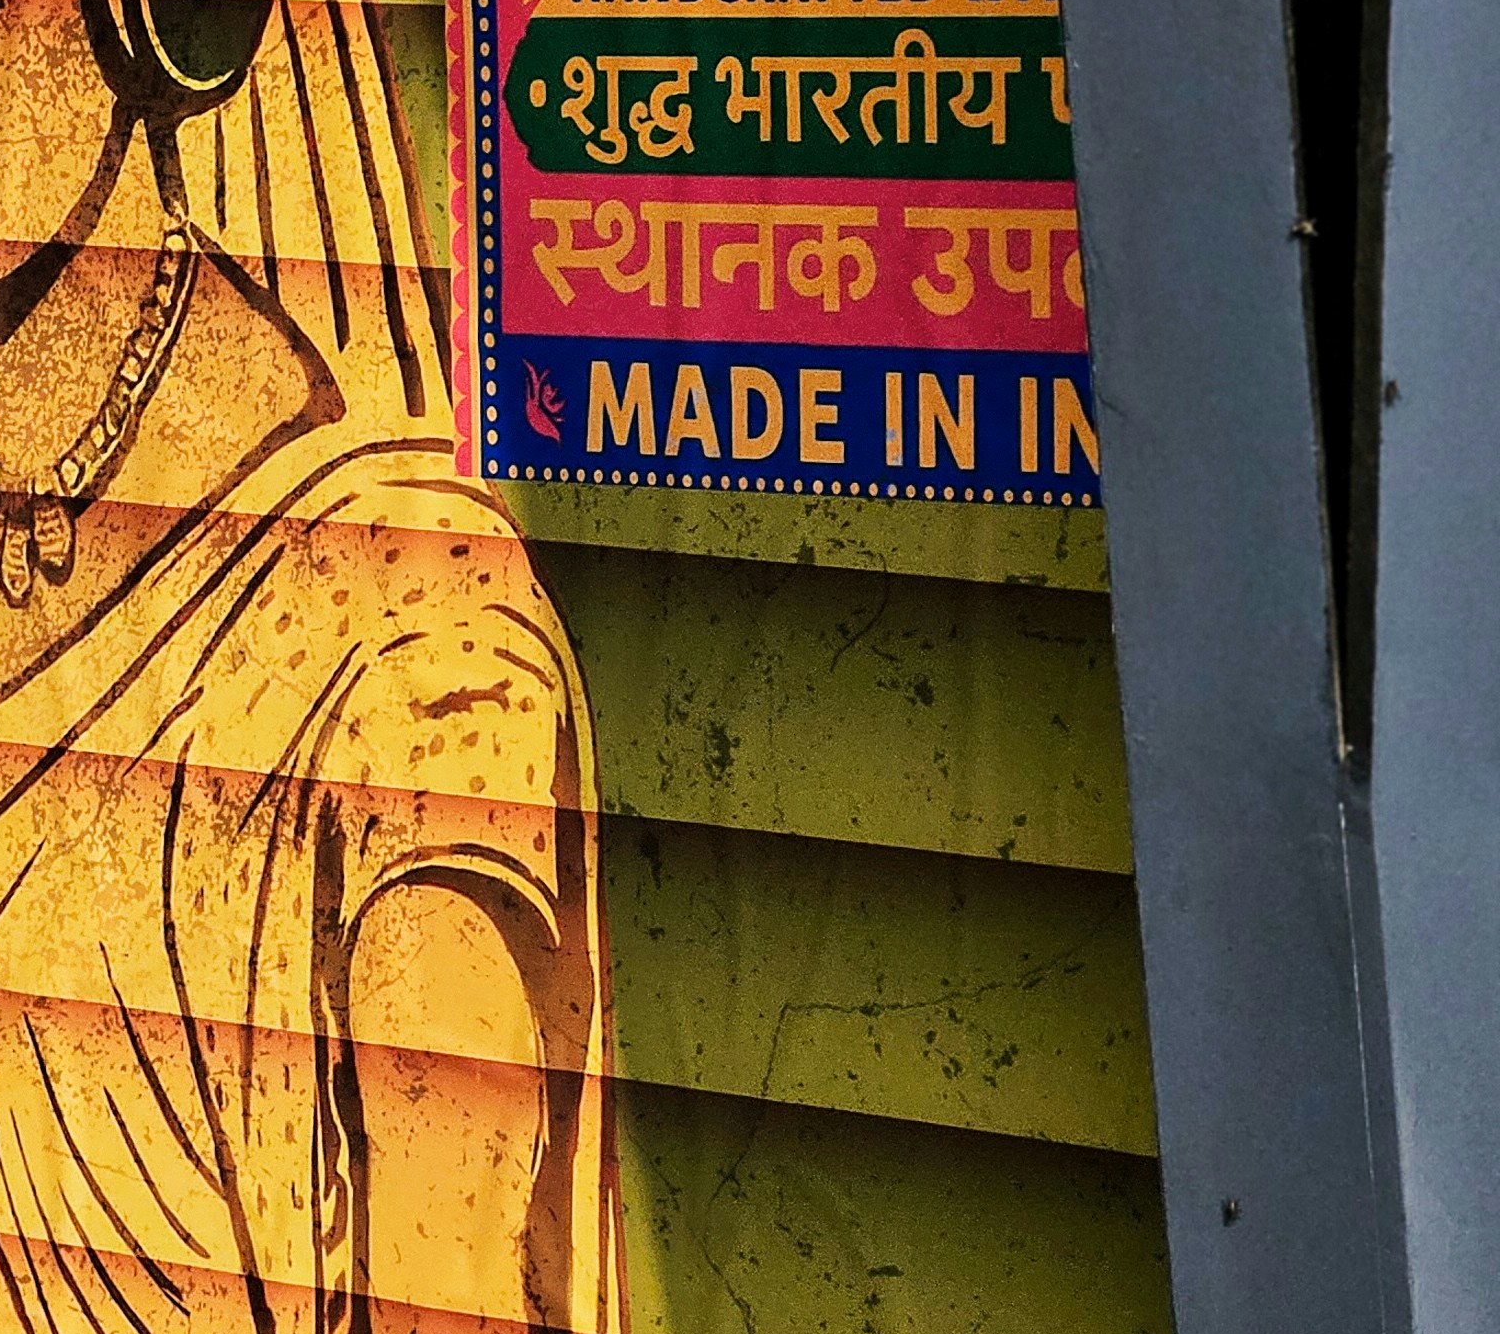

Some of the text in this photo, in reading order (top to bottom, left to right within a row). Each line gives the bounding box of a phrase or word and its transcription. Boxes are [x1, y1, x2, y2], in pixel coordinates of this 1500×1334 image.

[561, 56, 698, 165] शुद्ध
[715, 28, 1022, 147] भारतीय
[529, 199, 878, 313] स्थानक
[586, 360, 845, 464] MADE
[885, 371, 975, 470] IN
